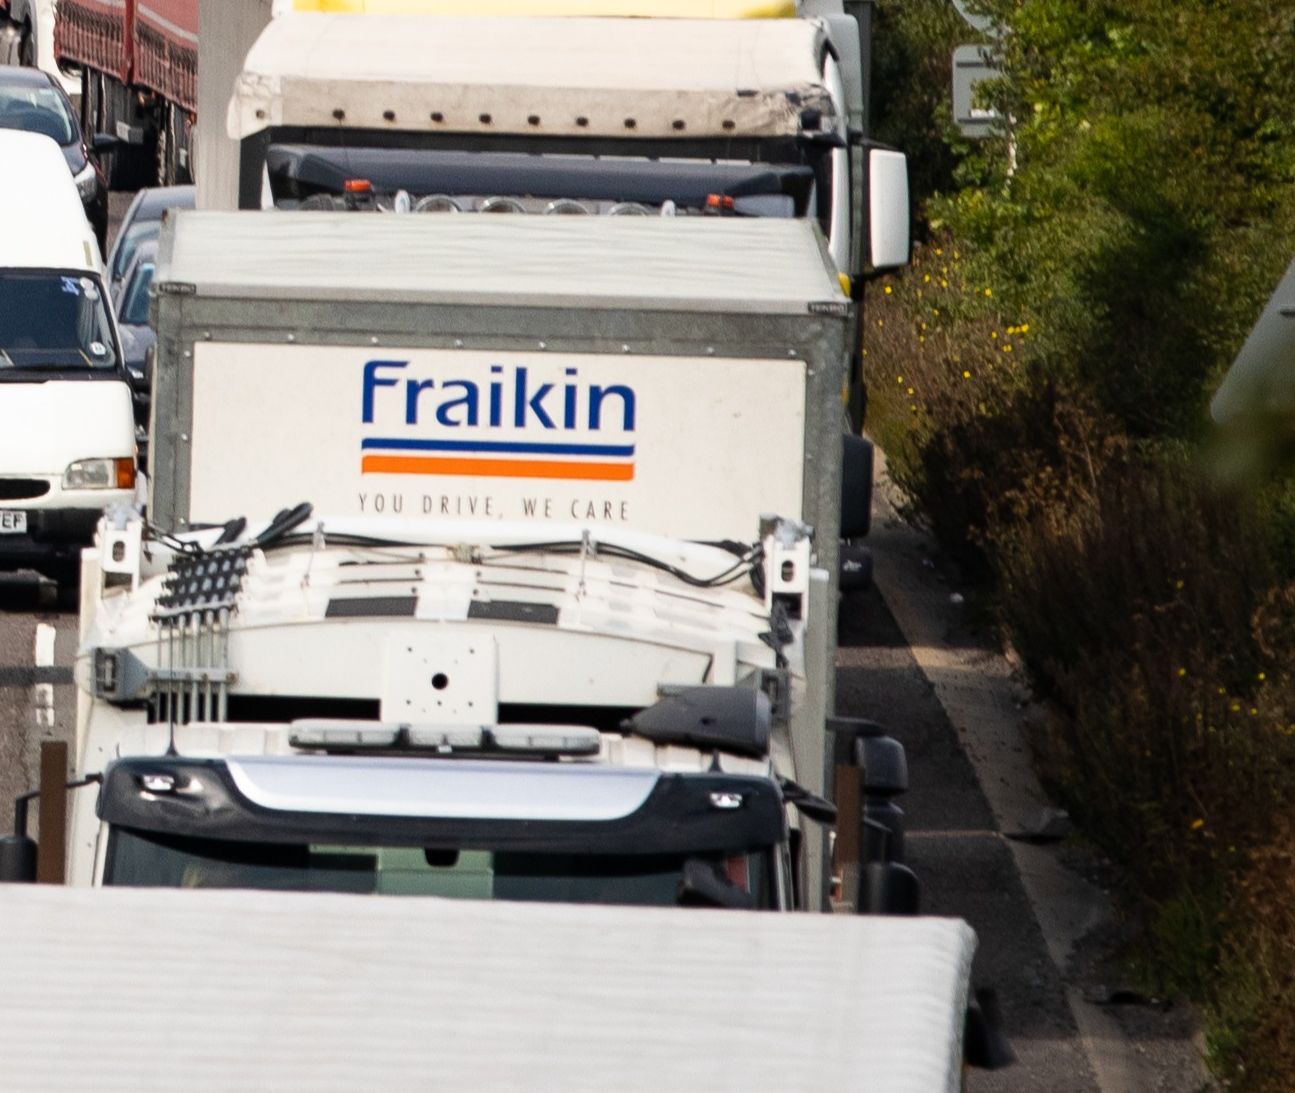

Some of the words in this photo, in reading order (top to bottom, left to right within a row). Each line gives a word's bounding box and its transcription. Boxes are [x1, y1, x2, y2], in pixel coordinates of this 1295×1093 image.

[362, 360, 636, 432] Fraikin
[358, 492, 403, 514] YOU
[423, 494, 503, 520] DRIVE,
[523, 498, 553, 517] WE
[571, 499, 630, 521] CARE
